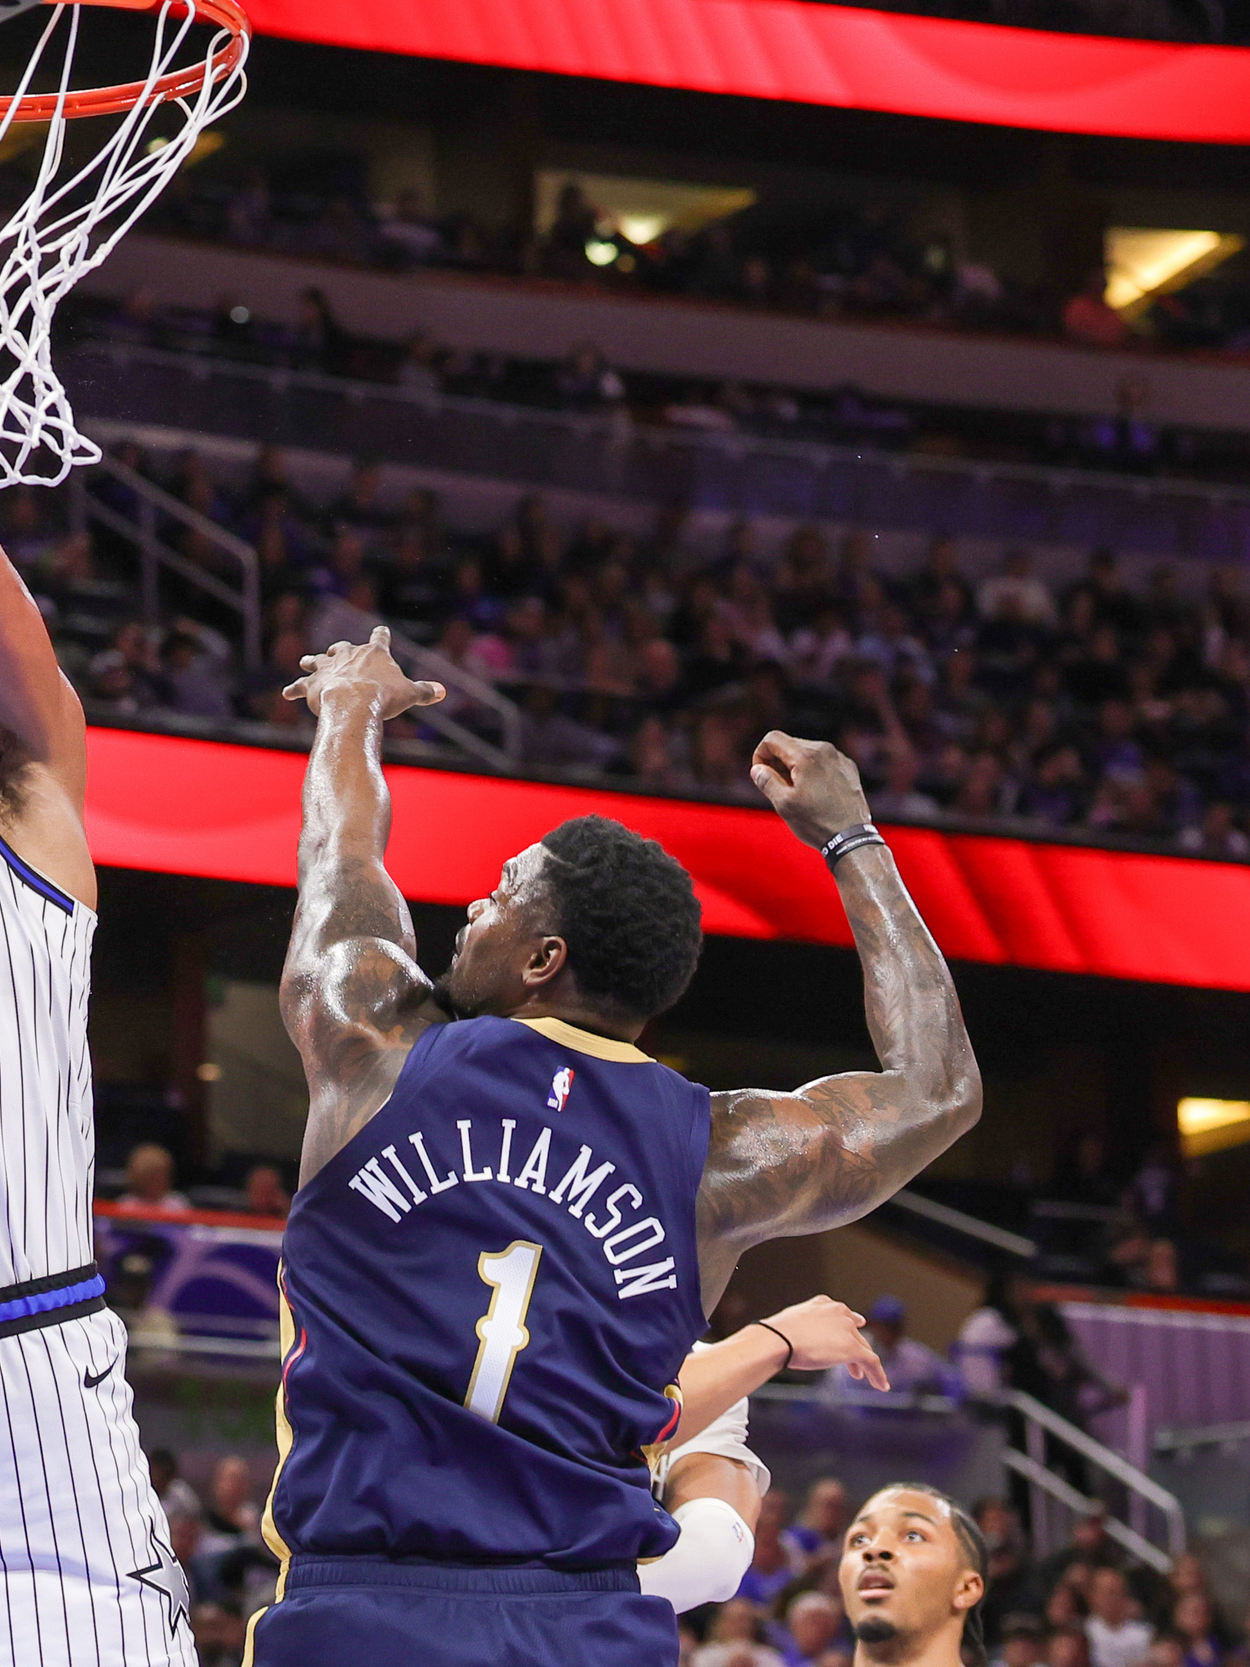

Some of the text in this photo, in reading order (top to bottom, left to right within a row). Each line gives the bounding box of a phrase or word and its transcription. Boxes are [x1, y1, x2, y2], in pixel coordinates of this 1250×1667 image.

[827, 833, 844, 850] DIE
[348, 1118, 677, 1300] WILLIAMSON
[463, 1239, 543, 1425] 1
